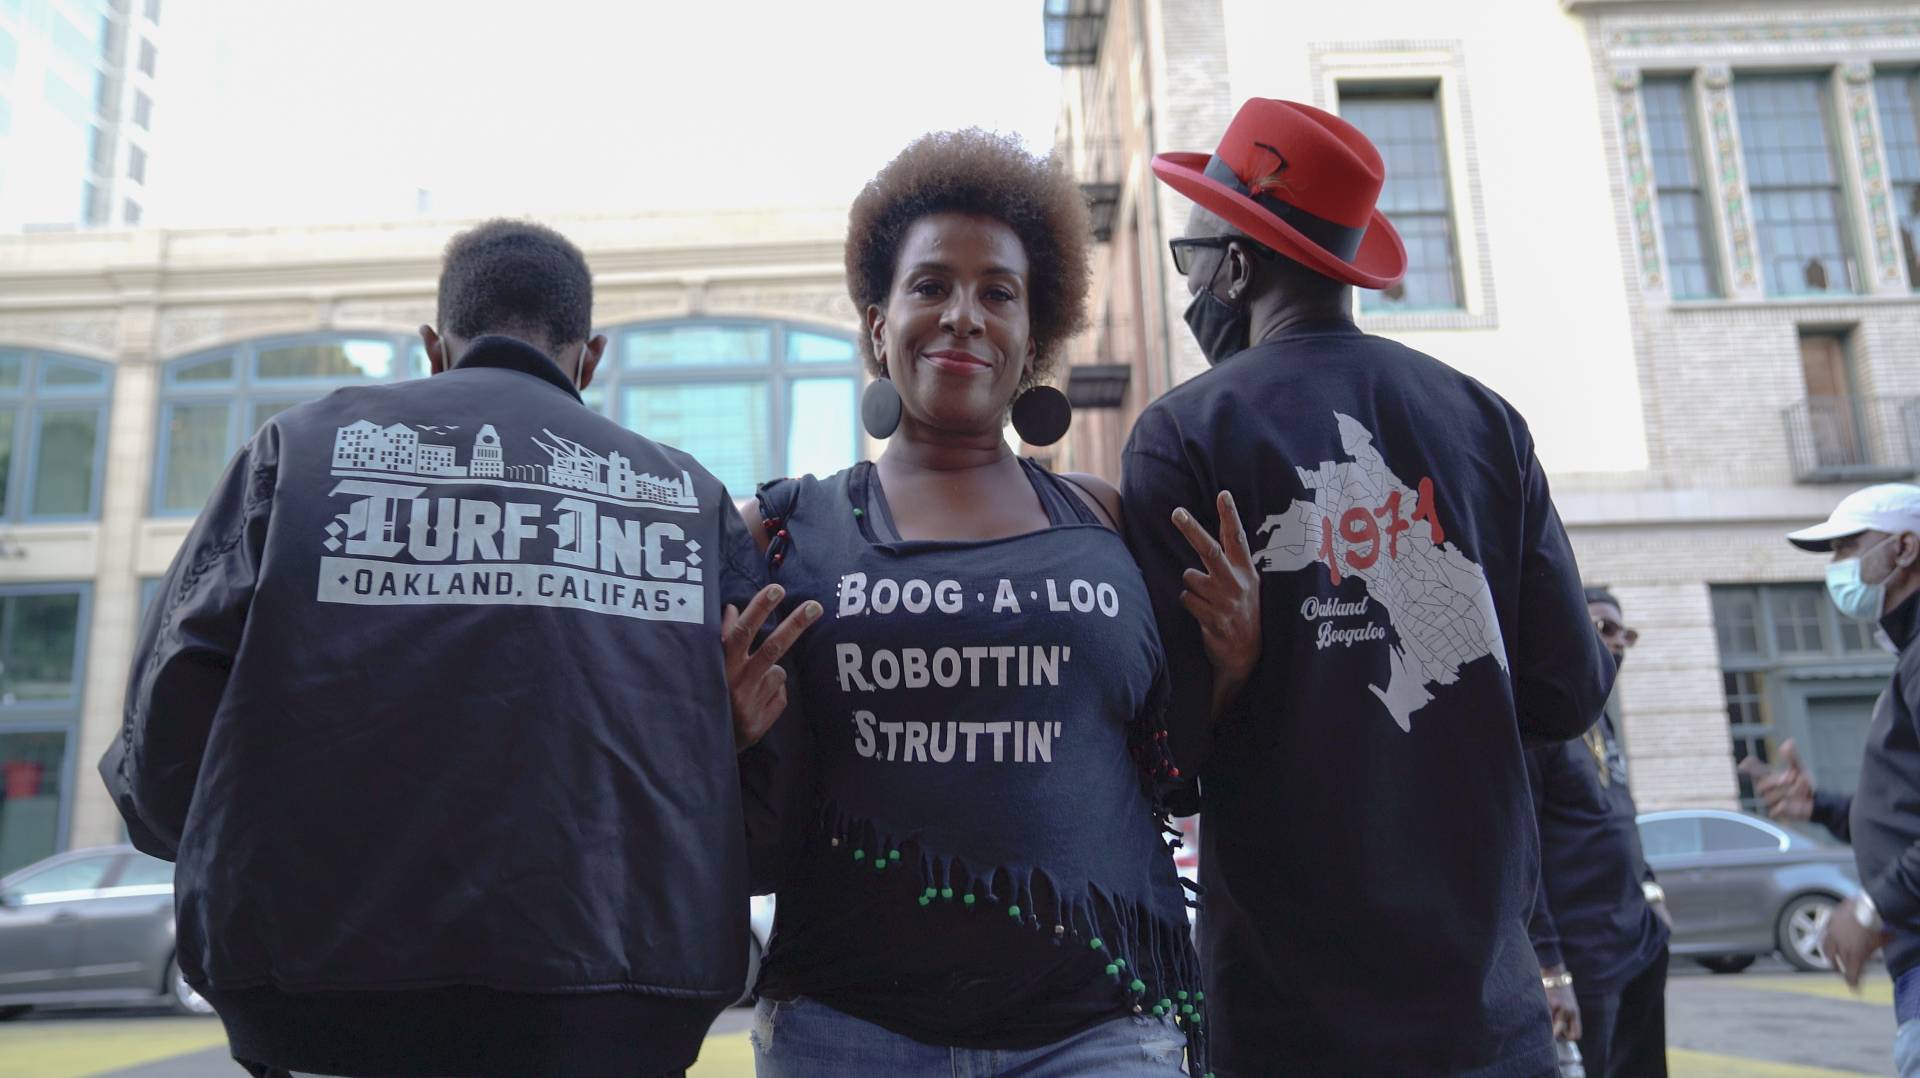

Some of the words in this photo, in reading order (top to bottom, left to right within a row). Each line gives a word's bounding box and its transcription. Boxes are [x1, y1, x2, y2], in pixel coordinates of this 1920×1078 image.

[328, 479, 541, 561] TURF
[1319, 476, 1444, 586] 1971
[355, 568, 523, 597] OAKLAND,
[538, 573, 671, 612] CALIFAS
[1301, 596, 1368, 621] Oakland
[1317, 621, 1386, 650] Boogaloo
[836, 643, 1071, 692] ROBOTTIN'
[853, 710, 1062, 763] STRUTTIN'
